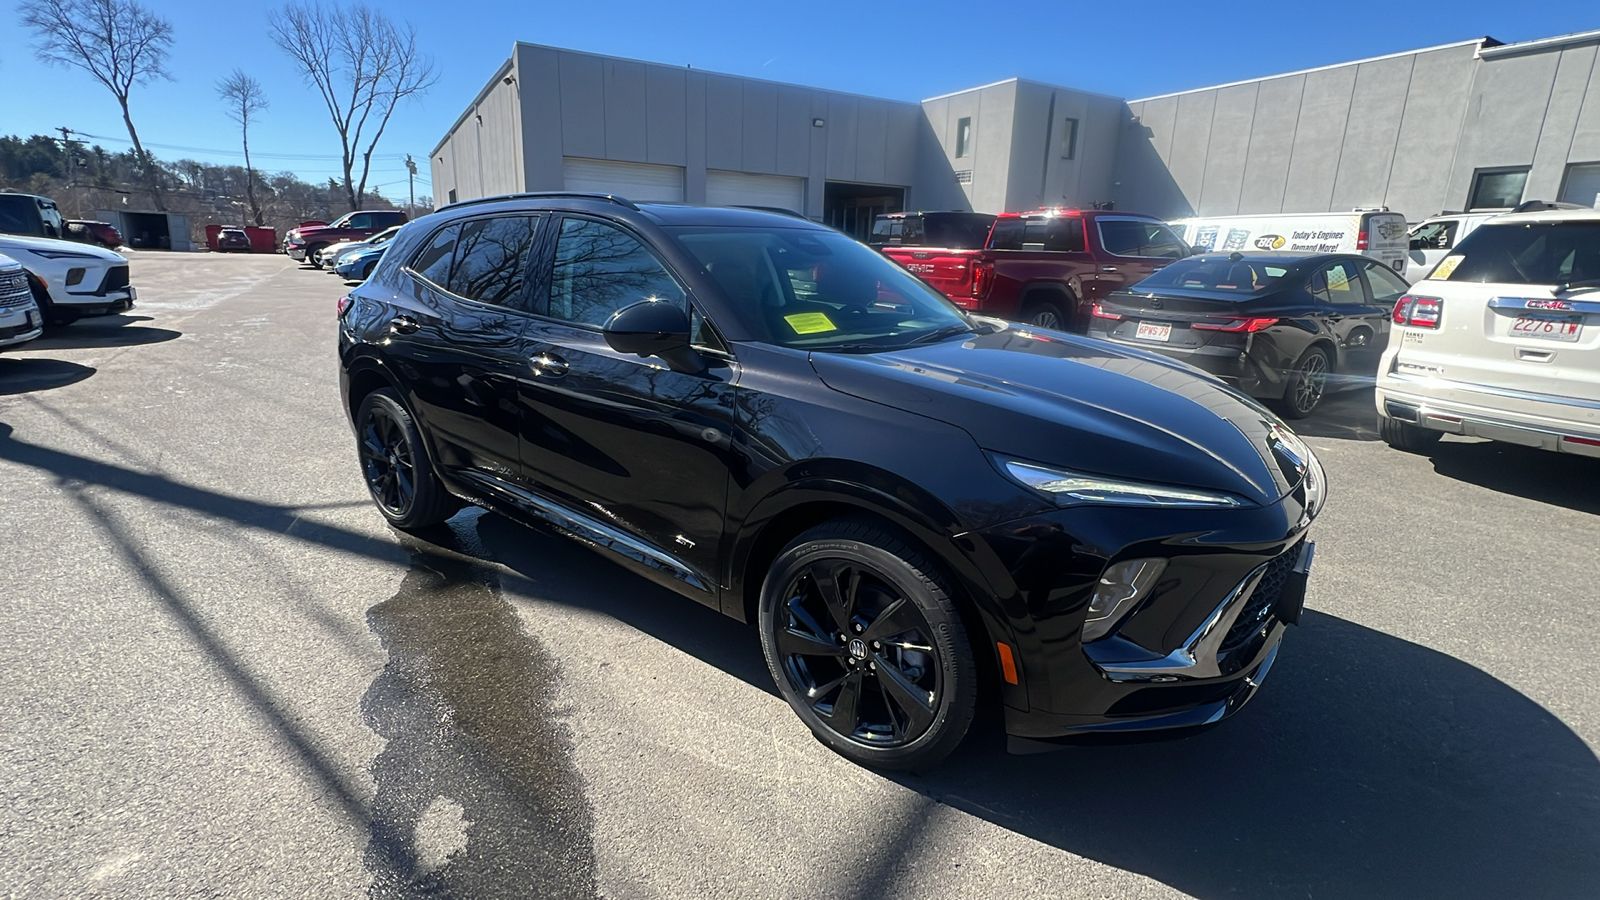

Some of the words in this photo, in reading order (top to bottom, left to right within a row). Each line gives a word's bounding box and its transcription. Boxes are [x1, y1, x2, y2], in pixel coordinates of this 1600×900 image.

[1291, 231, 1317, 240] Today's
[1317, 230, 1345, 240] Engines
[1291, 243, 1318, 251] Demand
[1318, 243, 1340, 252] More!
[907, 263, 935, 273] GMC
[1525, 300, 1573, 311] GMC
[1513, 317, 1554, 333] 2276
[1158, 327, 1169, 337] 79
